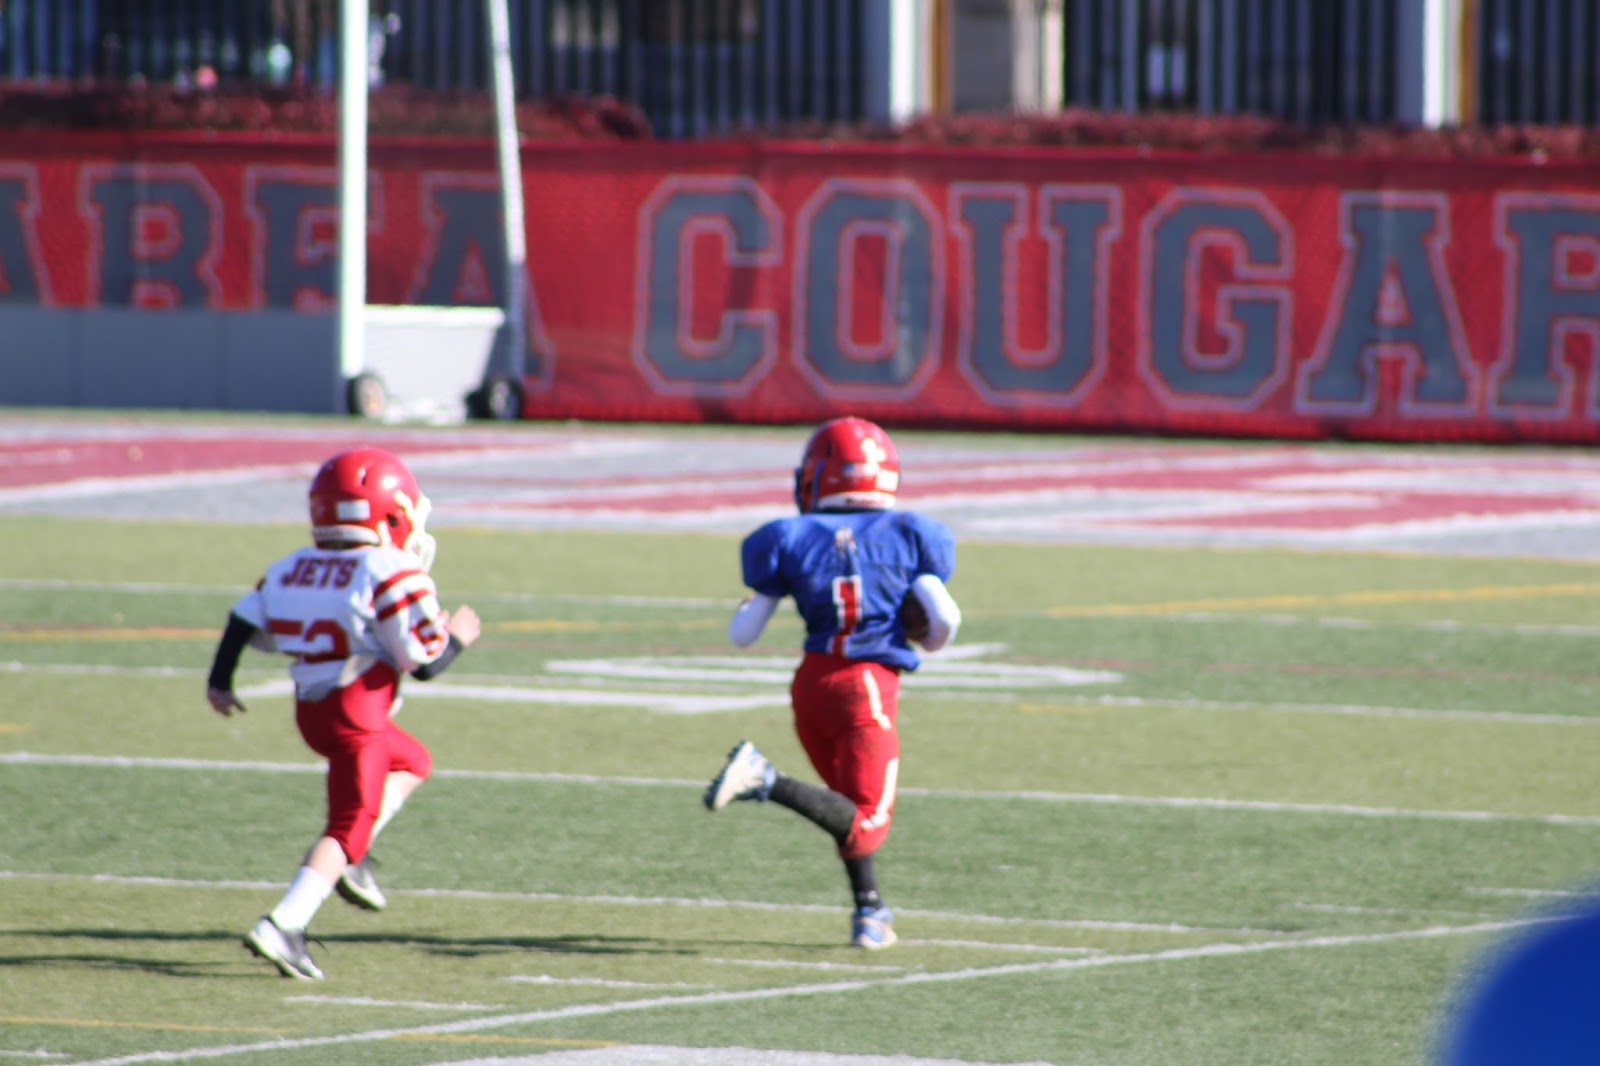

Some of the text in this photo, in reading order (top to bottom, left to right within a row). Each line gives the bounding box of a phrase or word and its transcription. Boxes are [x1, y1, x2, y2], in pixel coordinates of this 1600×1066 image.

[0, 162, 1600, 420] REA COUGAR
[282, 557, 358, 588] JETS
[829, 575, 861, 657] 1
